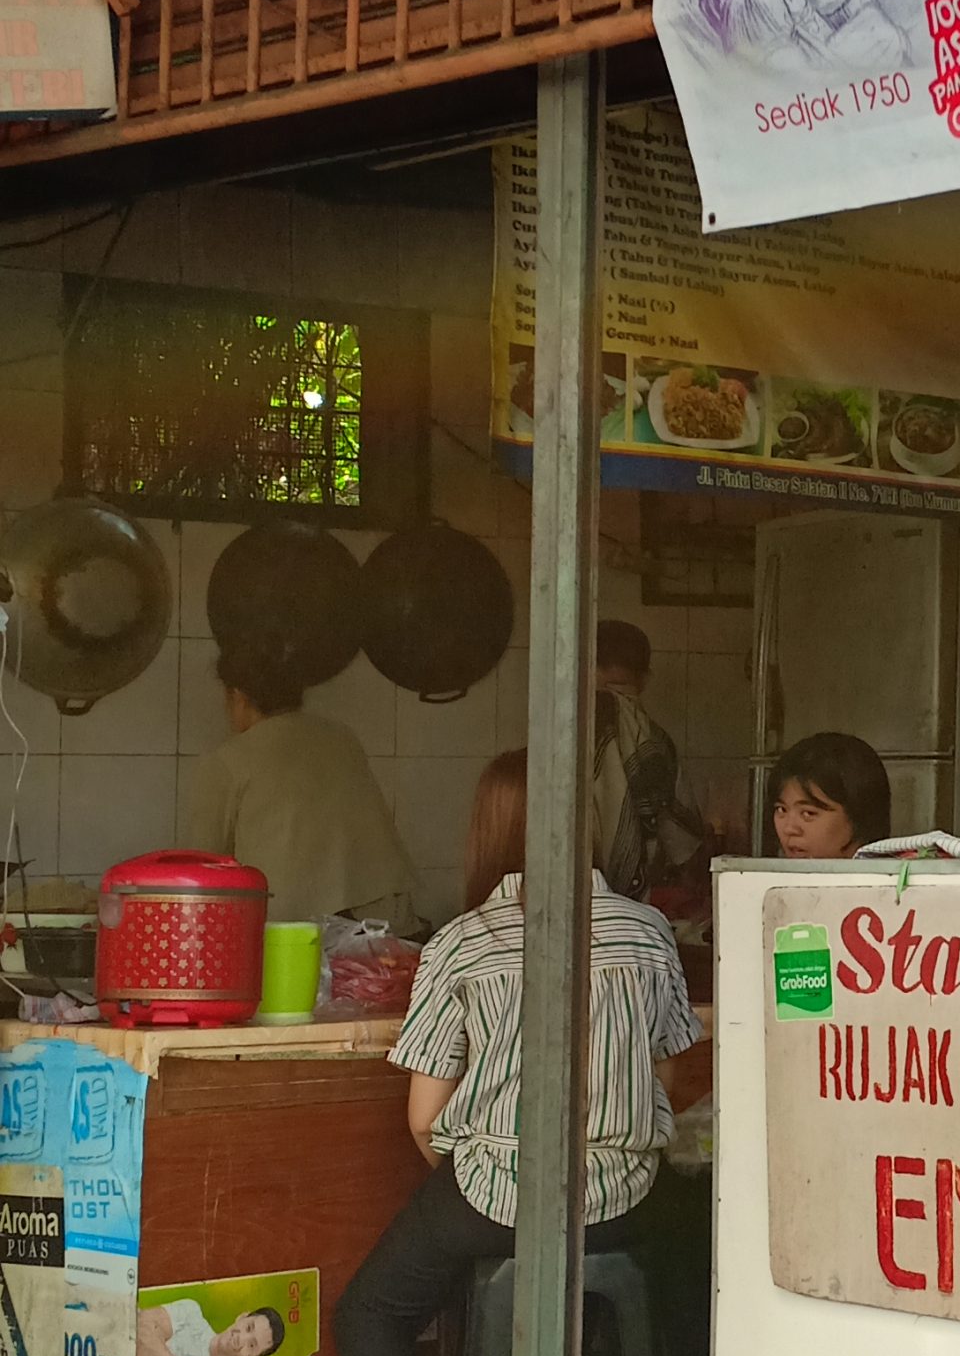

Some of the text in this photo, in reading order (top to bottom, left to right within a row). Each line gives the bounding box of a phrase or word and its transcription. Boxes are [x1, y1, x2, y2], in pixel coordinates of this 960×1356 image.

[755, 72, 911, 133] Sedjak 1950
[617, 292, 647, 309] Nasi
[617, 310, 648, 327] Nasi
[605, 327, 657, 349] Goreng
[669, 334, 700, 351] Nasi
[780, 972, 828, 991] GrabFood
[819, 1023, 954, 1107] RUJAK
[0, 1202, 60, 1237] Aroma
[6, 1238, 50, 1260] PUAS
